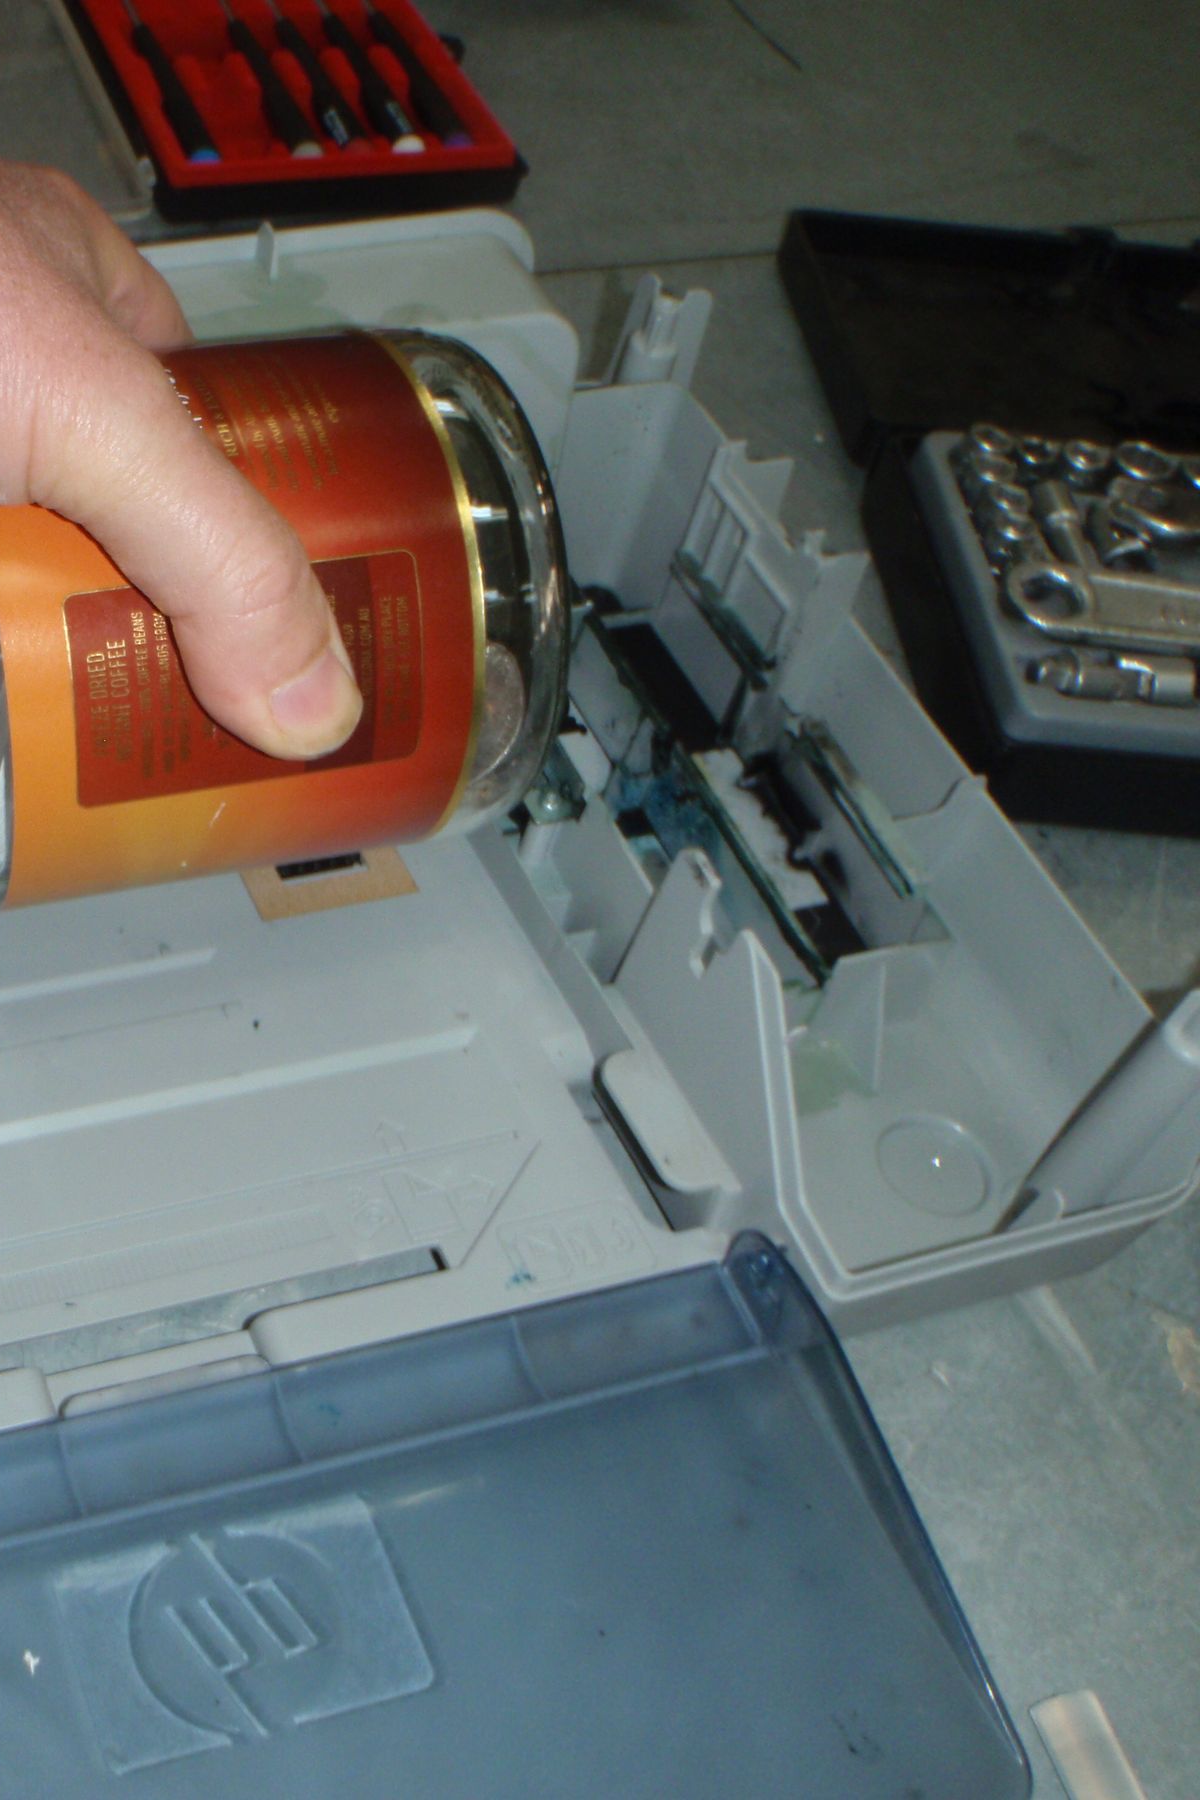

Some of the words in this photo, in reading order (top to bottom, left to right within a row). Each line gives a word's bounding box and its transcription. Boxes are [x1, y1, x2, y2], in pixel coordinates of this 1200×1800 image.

[216, 423, 239, 457] RICH
[131, 610, 146, 645] BEANS
[86, 652, 108, 700] DRIED
[107, 638, 130, 698] COFFEE
[135, 646, 150, 686] COFFEE
